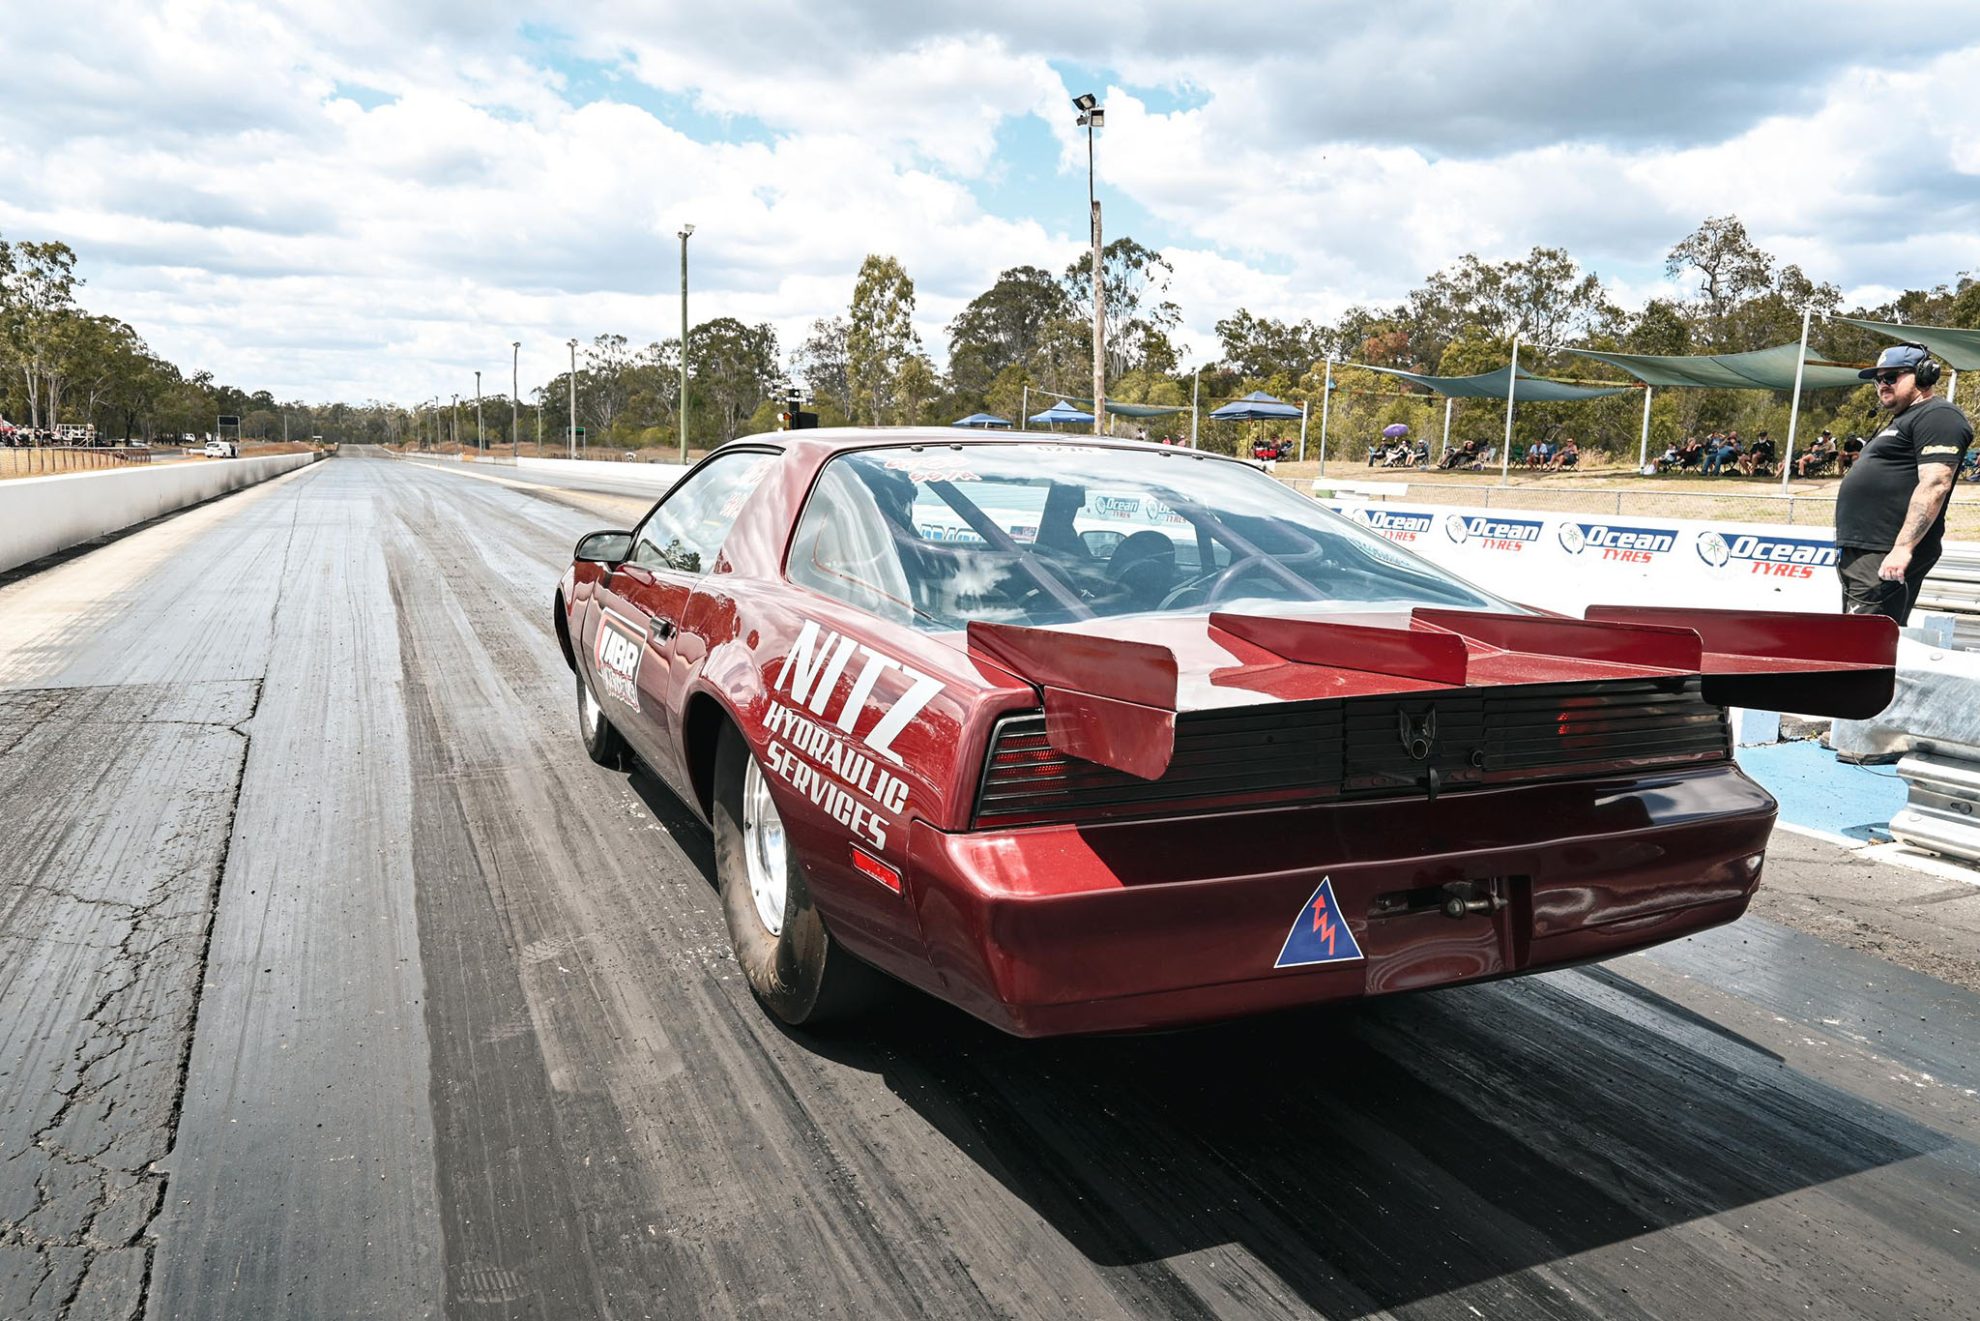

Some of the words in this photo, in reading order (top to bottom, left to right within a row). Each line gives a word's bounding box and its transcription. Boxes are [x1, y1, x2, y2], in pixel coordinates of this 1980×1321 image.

[1106, 498, 1138, 512] Ocean
[1371, 511, 1431, 533] Ocean
[1468, 517, 1540, 541] Ocean
[1381, 530, 1417, 541] TYRES
[1482, 538, 1522, 551] TYRES
[1586, 525, 1673, 551] Ocean
[1602, 548, 1653, 563] TYRES
[1730, 535, 1838, 566] Ocean
[1751, 561, 1815, 578] TYRES
[773, 618, 947, 767] NITZ
[762, 700, 910, 815] HYDRAULIC
[763, 740, 890, 850] SERVICES
